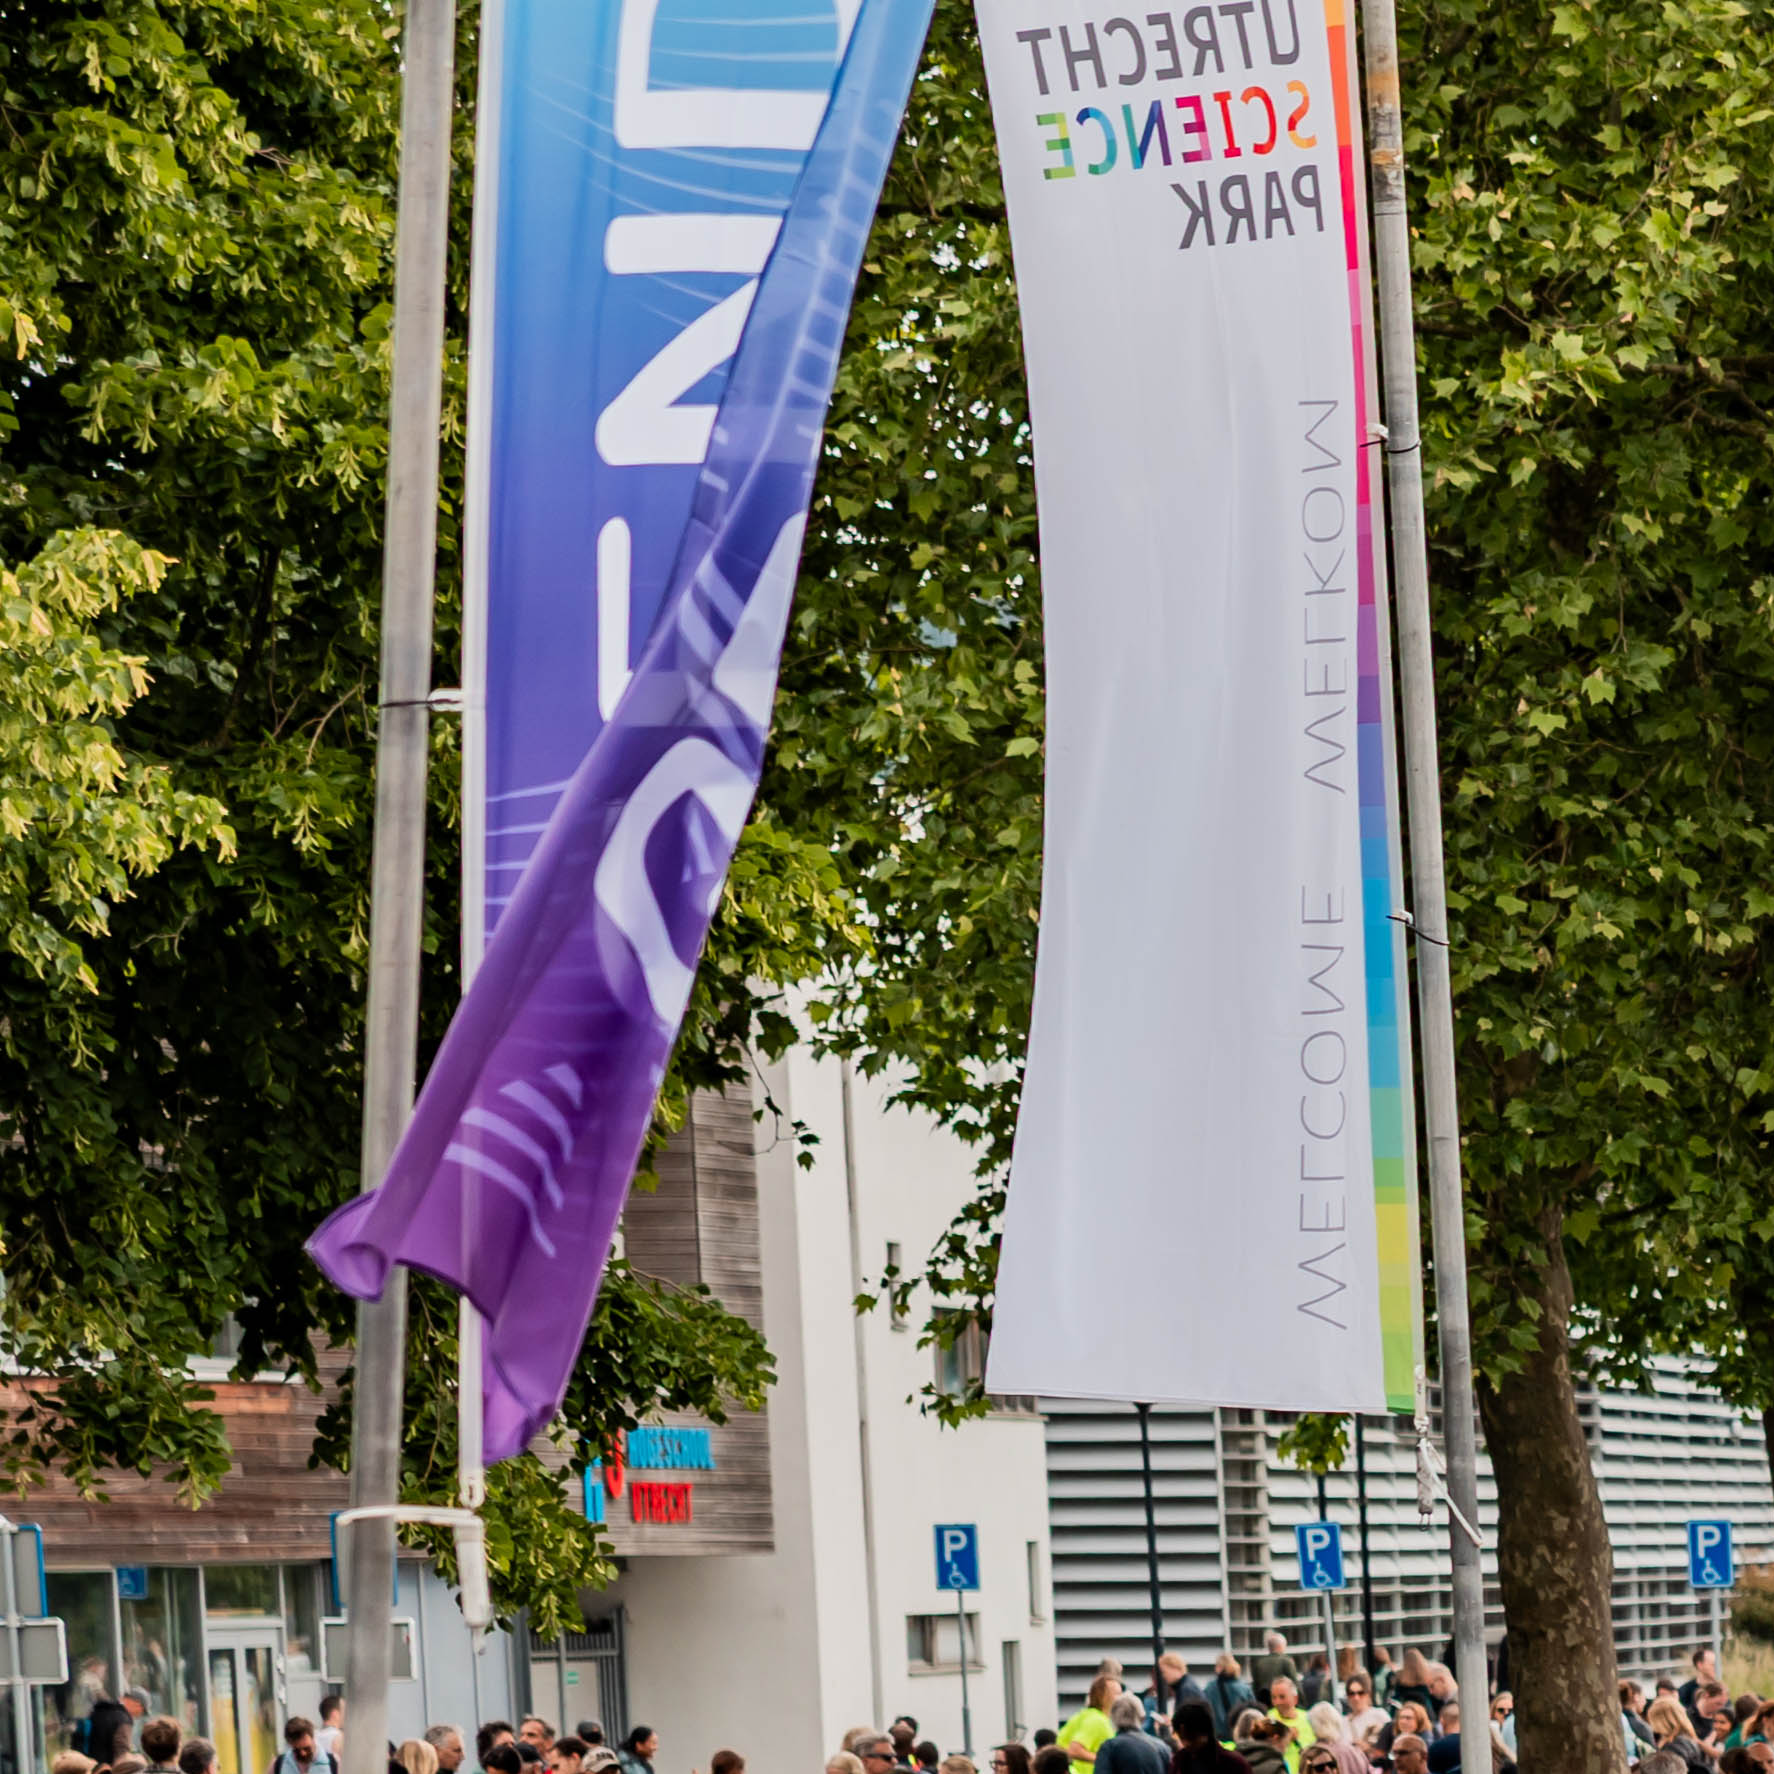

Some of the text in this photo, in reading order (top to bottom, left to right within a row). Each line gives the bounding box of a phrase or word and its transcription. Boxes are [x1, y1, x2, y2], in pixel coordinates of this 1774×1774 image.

[944, 1529, 967, 1553] P
[1306, 1528, 1331, 1552] P
[1697, 1525, 1721, 1550] P
